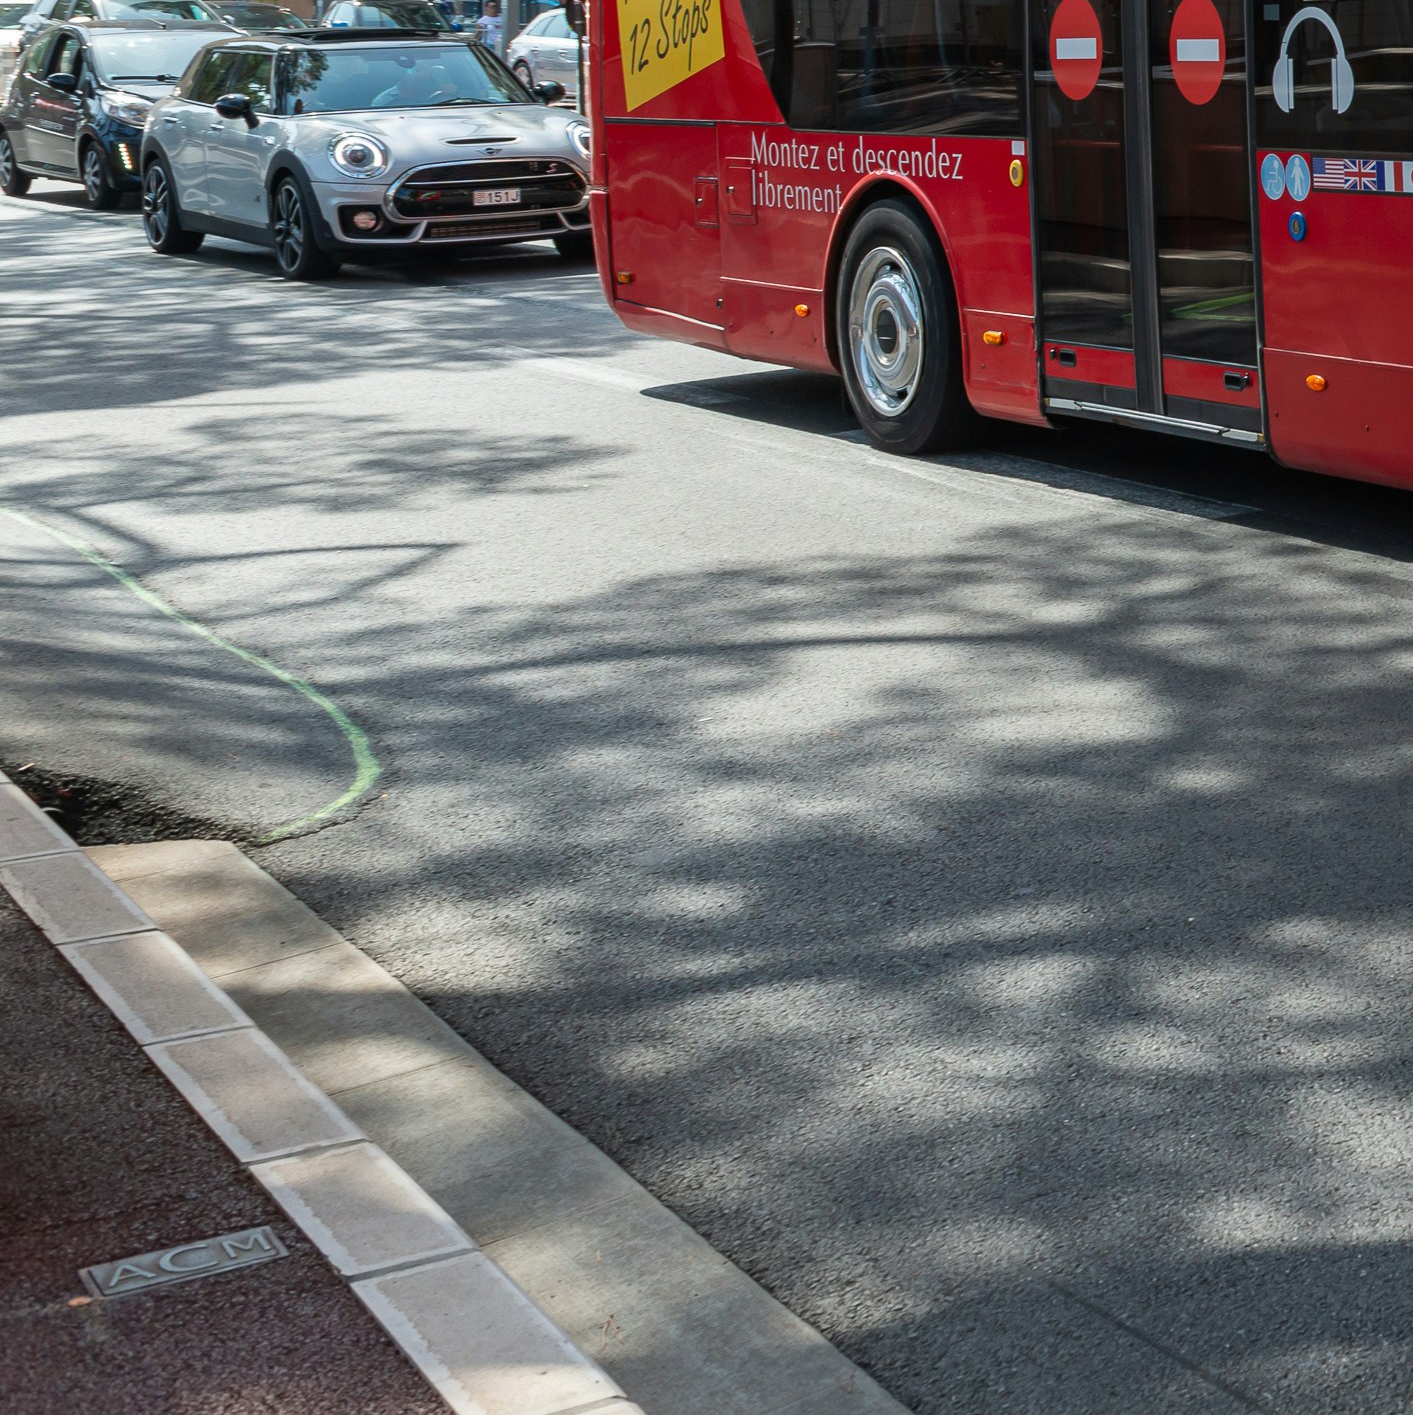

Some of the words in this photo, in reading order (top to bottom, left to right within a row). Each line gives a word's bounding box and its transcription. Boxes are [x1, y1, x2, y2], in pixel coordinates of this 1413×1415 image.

[630, 19, 650, 75] 12
[750, 132, 821, 172] Montez
[828, 140, 845, 172] et
[853, 135, 964, 180] descendez
[487, 191, 520, 203] 151J
[751, 169, 842, 215] librement
[108, 1231, 274, 1287] ACM
